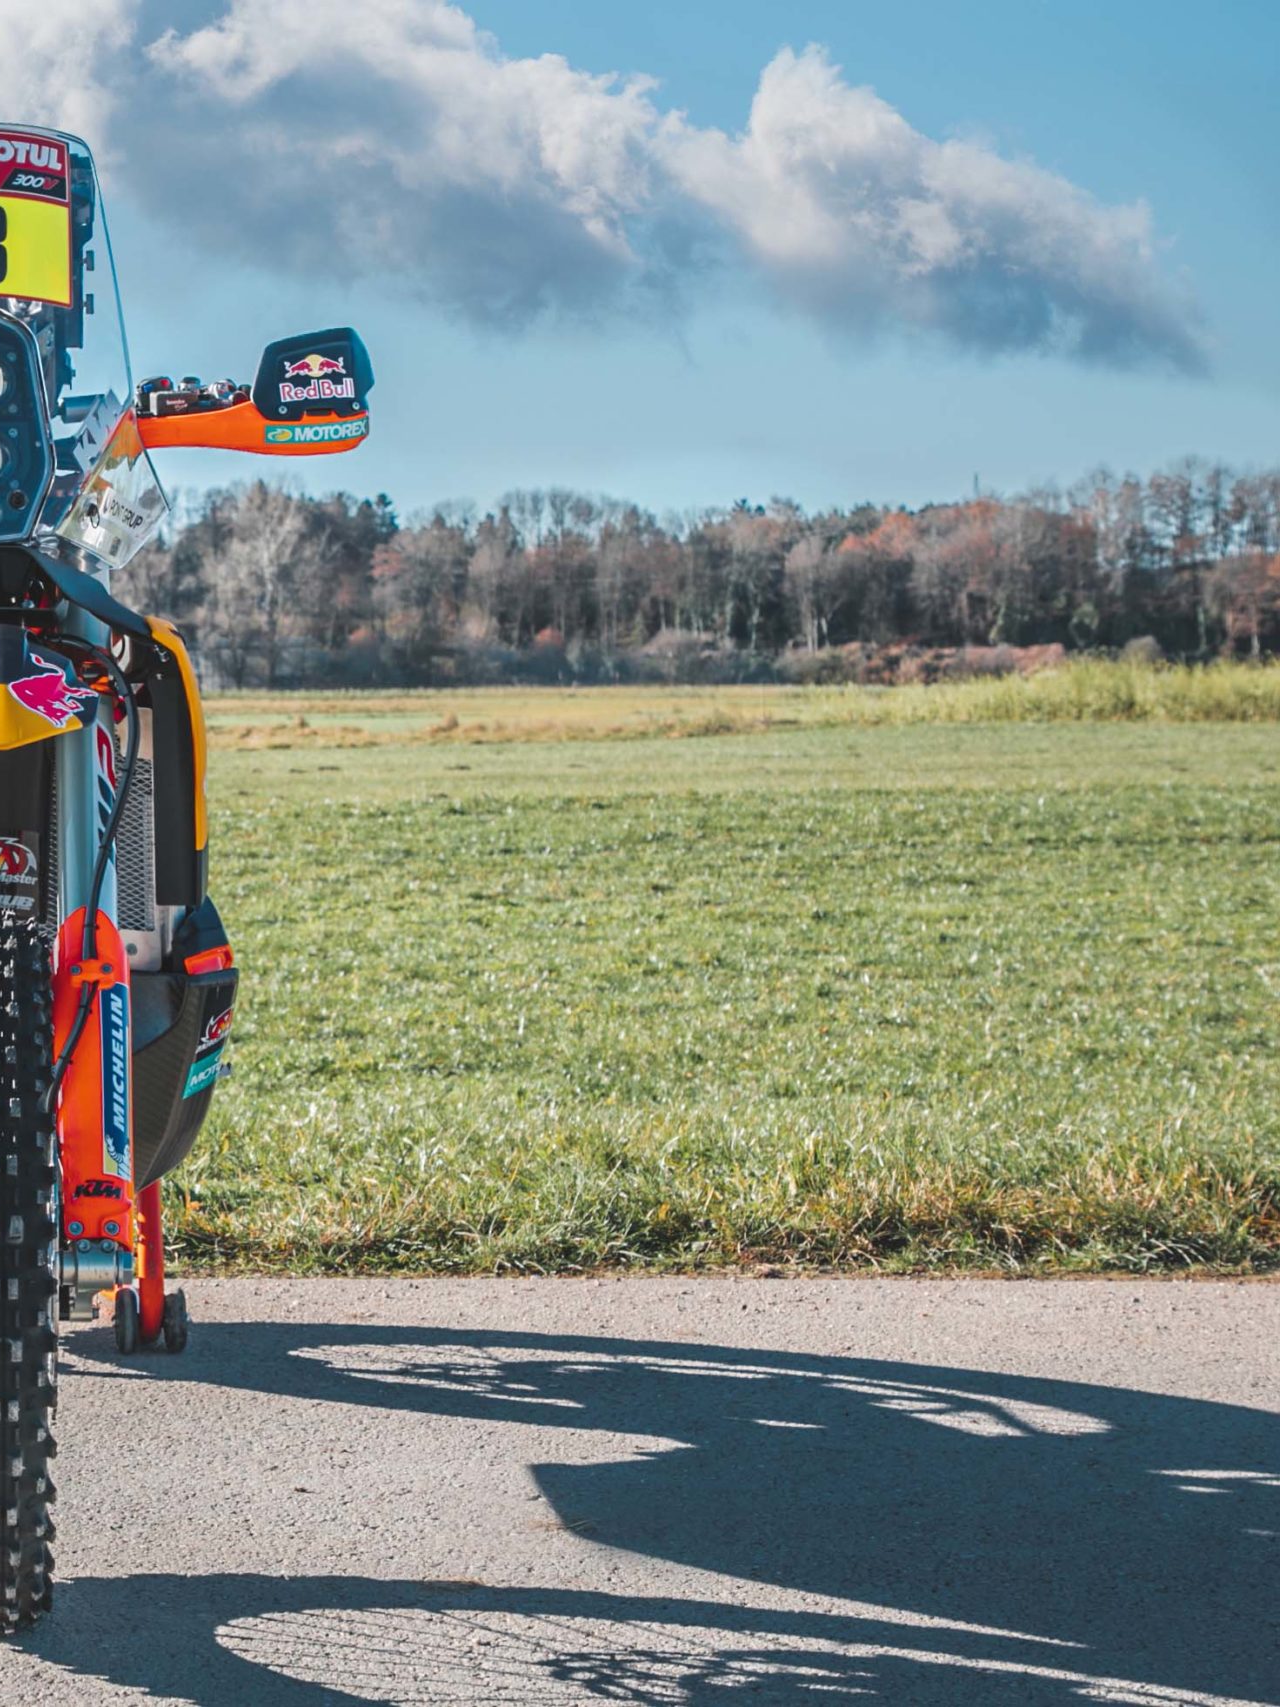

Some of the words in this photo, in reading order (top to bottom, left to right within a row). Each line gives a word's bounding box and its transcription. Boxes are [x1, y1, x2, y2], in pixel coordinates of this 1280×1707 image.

[12, 173, 60, 191] 300V
[279, 379, 318, 403] Red
[320, 378, 355, 399] Bull
[294, 419, 367, 442] MOTOREX
[110, 993, 125, 1133] MICHELIN
[74, 1179, 122, 1200] KTM
